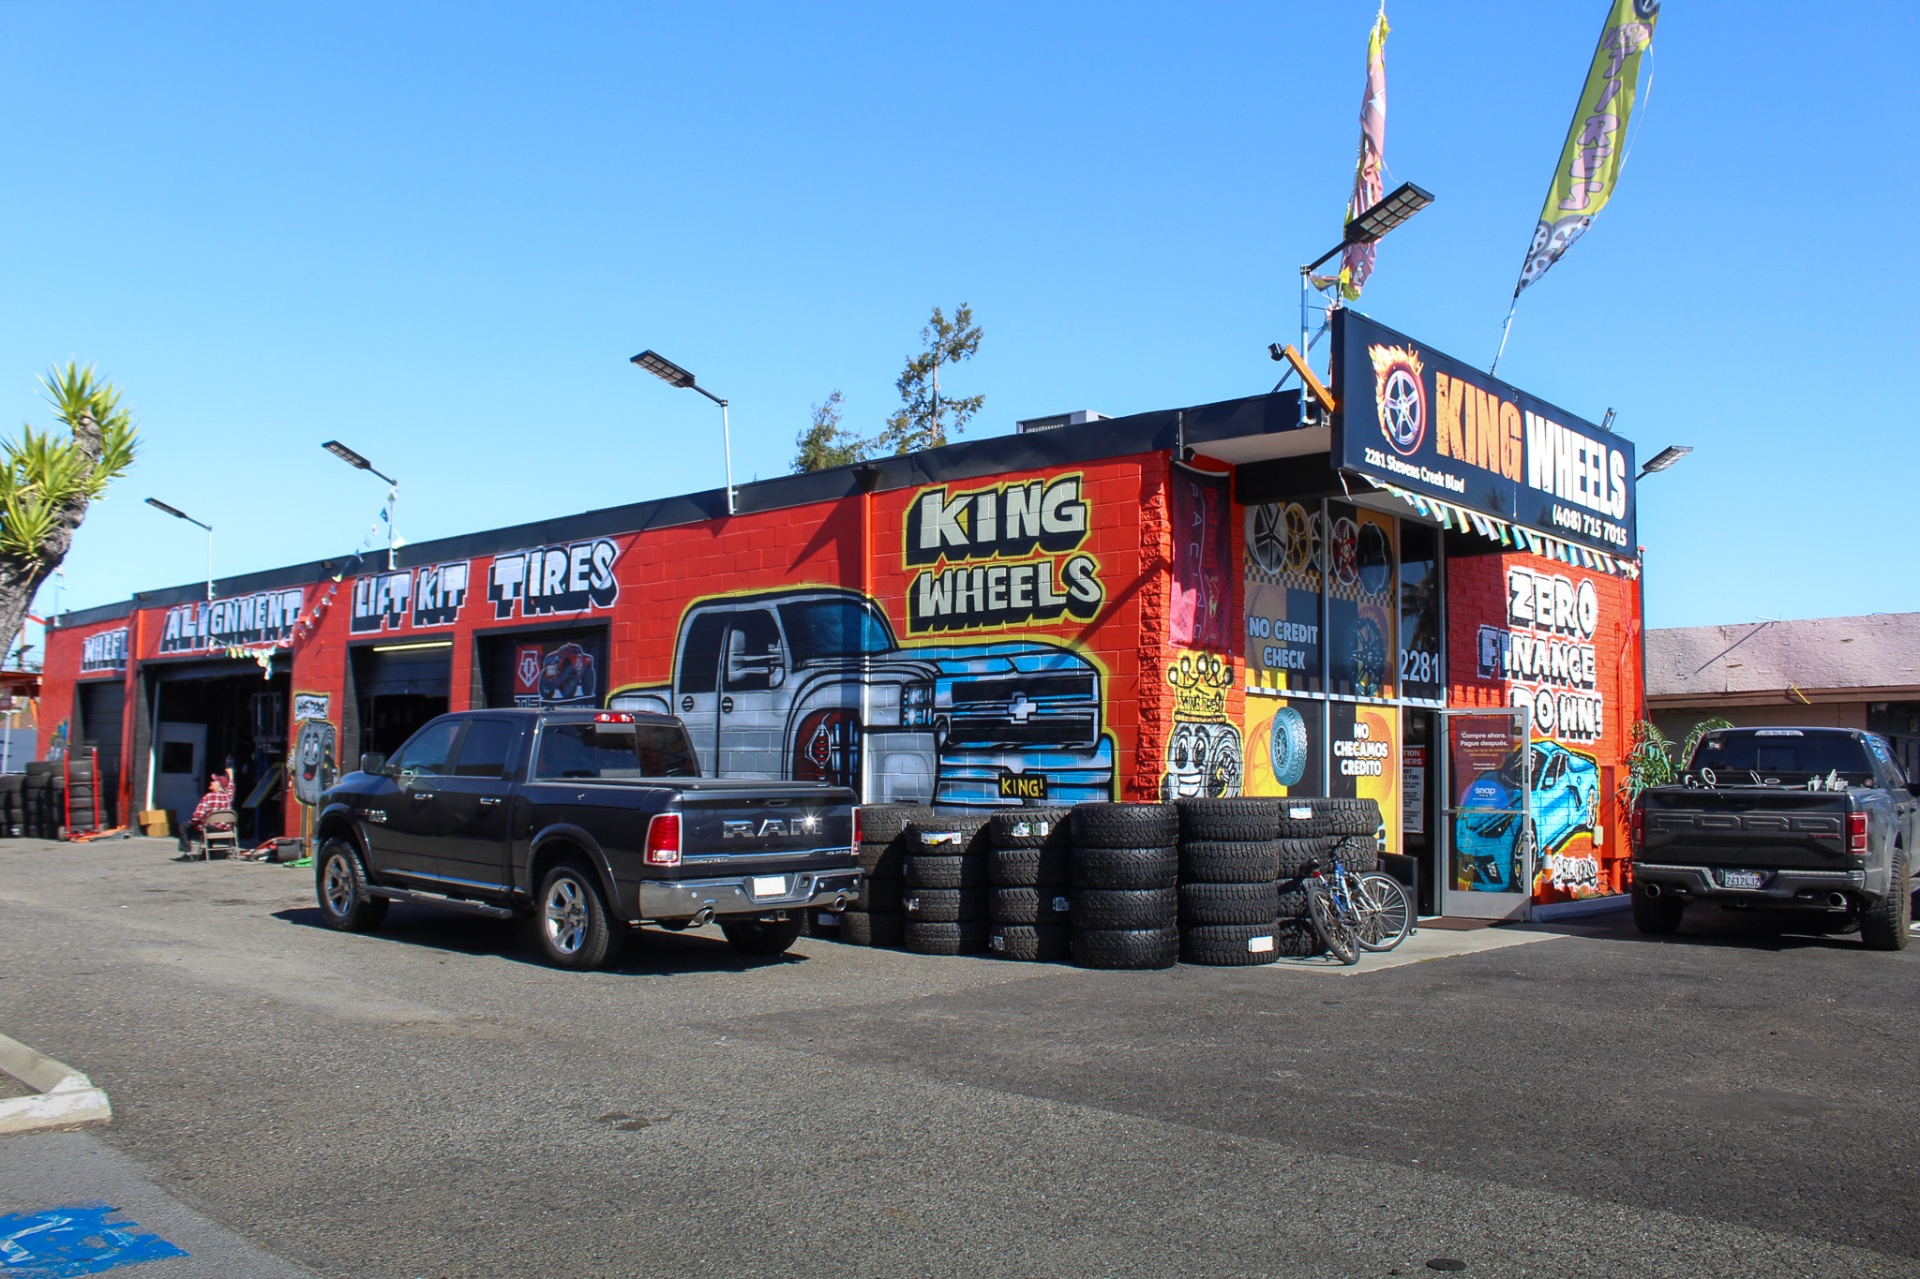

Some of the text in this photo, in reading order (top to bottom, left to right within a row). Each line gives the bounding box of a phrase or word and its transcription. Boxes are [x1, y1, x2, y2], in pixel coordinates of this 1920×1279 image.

[1558, 45, 1638, 210] TIRES
[1364, 447, 1386, 468] 2281
[1386, 455, 1420, 479] Stevens
[1420, 466, 1444, 487] Creek
[1436, 371, 1626, 520] KING WHEELS
[908, 476, 1087, 560] KING
[1552, 504, 1628, 547] (408) 715 7015
[491, 540, 617, 609] TIRES
[1190, 482, 1205, 640] RACING
[353, 562, 469, 624] LIFT KIT
[911, 554, 1103, 627] WHEELS
[1509, 567, 1597, 639] ZERO
[161, 589, 302, 647] ALIGNMENT
[1249, 616, 1318, 644] NO CREDIT
[1263, 646, 1306, 670] CHECK
[1400, 649, 1439, 684] 2281
[1478, 626, 1595, 689] FINANCE
[1353, 722, 1370, 740] NO
[1001, 773, 1044, 798] KING!
[1340, 759, 1382, 777] CREDITO
[1474, 787, 1496, 796] snap
[723, 819, 823, 838] RAM
[1651, 813, 1841, 832] FORD
